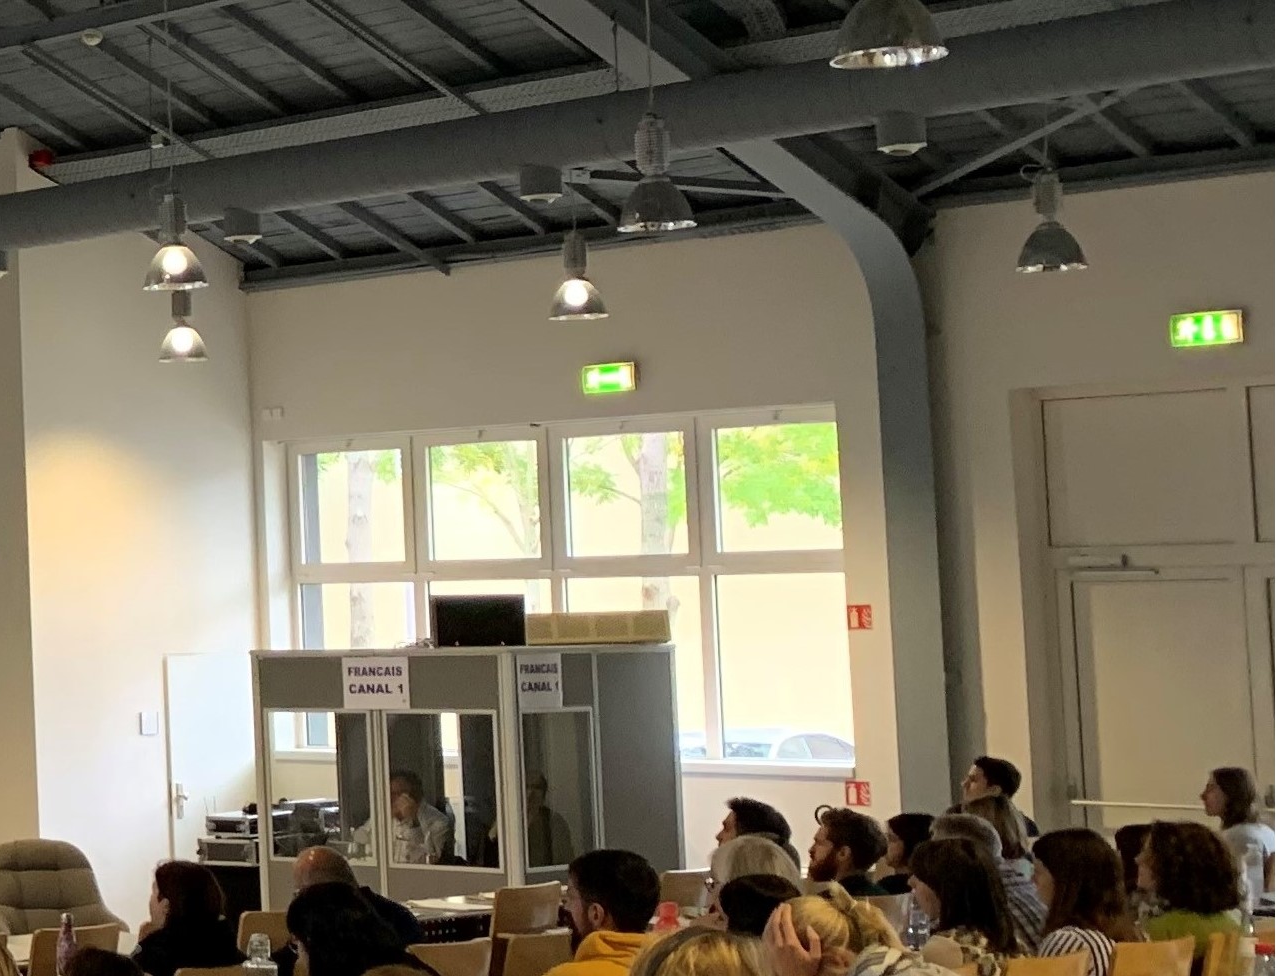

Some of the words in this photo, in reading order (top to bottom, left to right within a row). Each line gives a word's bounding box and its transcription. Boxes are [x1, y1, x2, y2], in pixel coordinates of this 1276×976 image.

[348, 666, 403, 678] FRANCAIS
[519, 663, 559, 675] FRANCAIS
[349, 683, 393, 695] CANAL
[397, 684, 404, 695] 1
[520, 681, 552, 693] CANAL
